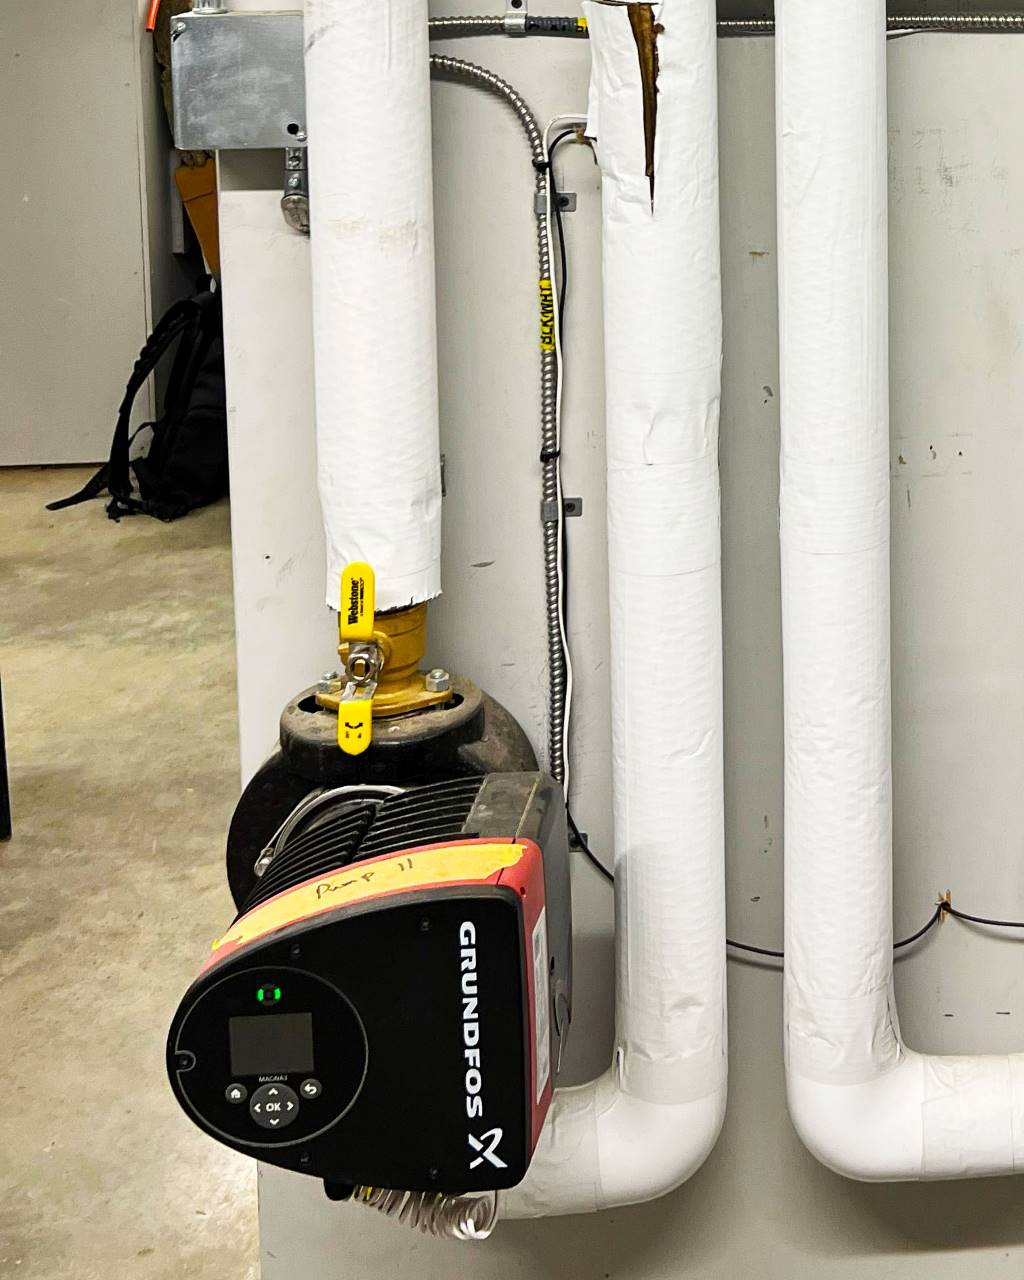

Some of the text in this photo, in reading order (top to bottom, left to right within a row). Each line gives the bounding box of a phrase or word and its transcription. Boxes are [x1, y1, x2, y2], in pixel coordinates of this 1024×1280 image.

[347, 580, 359, 625] Webstone
[315, 870, 376, 900] Pump
[458, 920, 484, 1119] GRUNDFOS
[265, 1102, 281, 1112] OK
